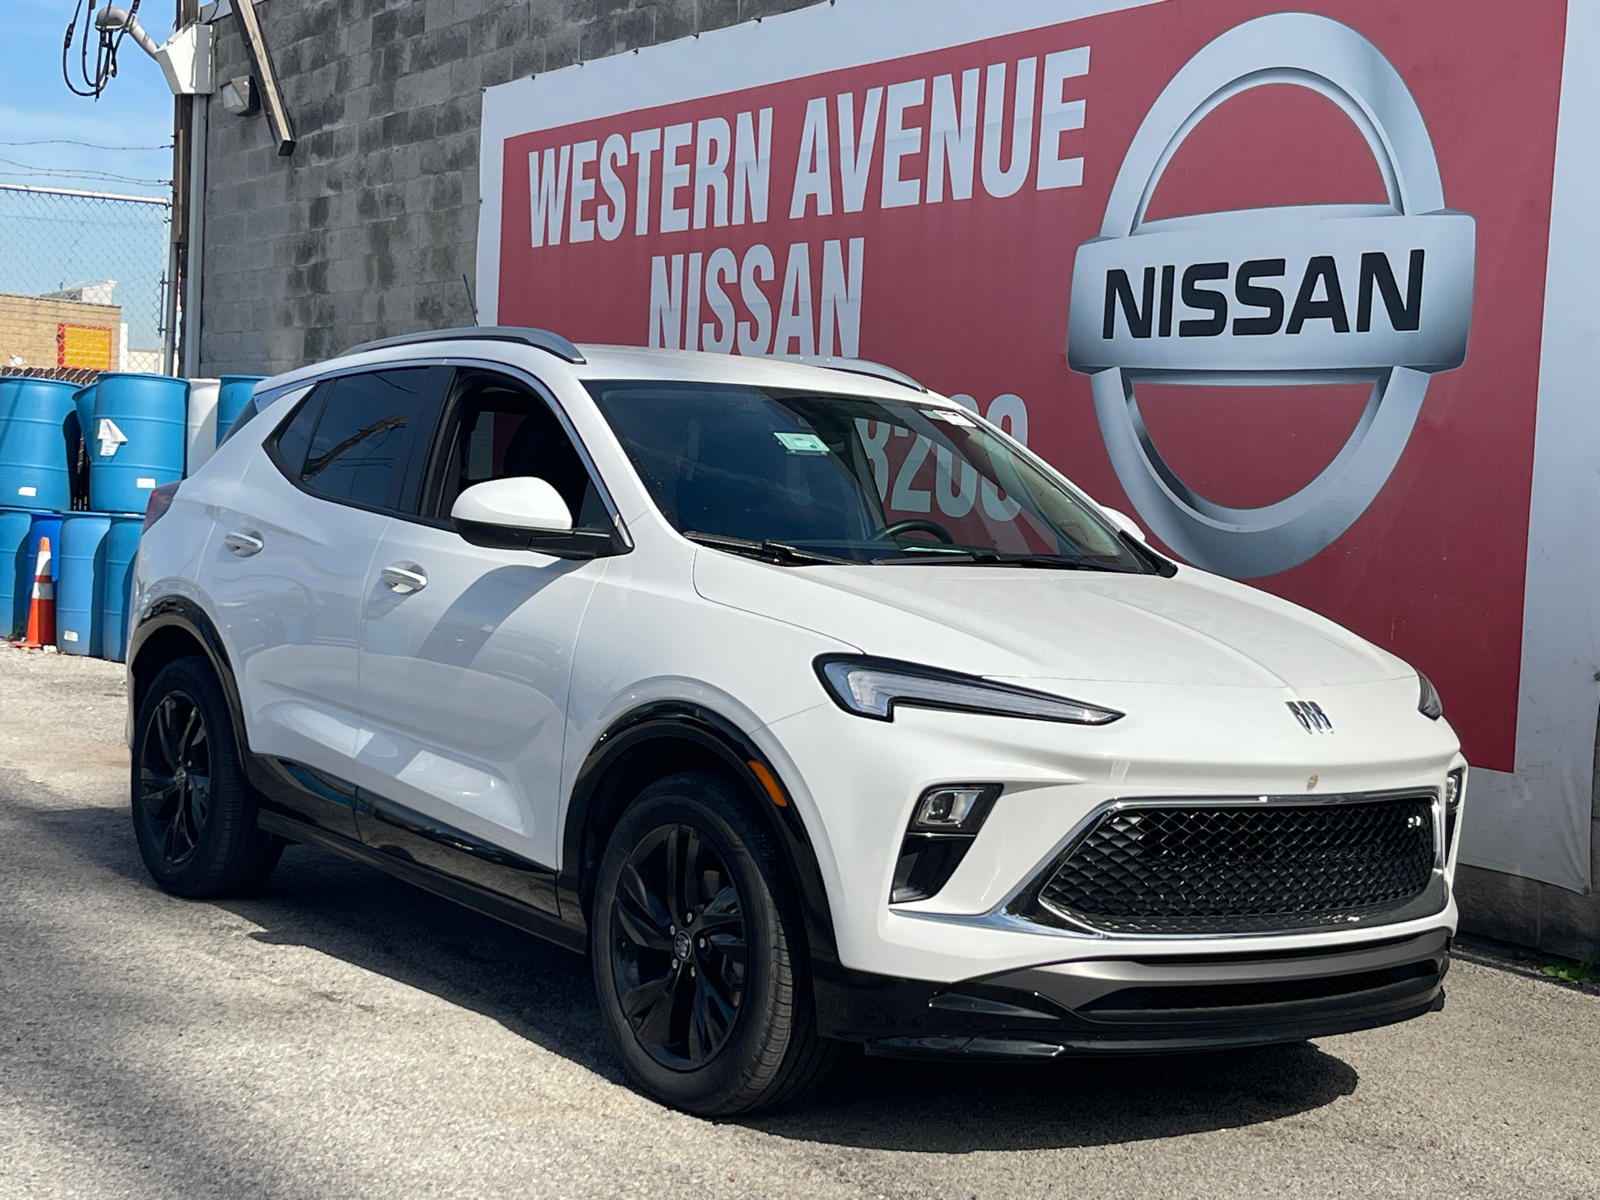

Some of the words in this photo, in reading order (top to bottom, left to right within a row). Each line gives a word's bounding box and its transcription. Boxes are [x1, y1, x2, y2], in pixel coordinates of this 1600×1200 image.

[528, 106, 774, 248] WESTERN
[788, 45, 1091, 219] AVENUE
[648, 236, 865, 359] NISSAN
[1102, 248, 1425, 340] NISSAN
